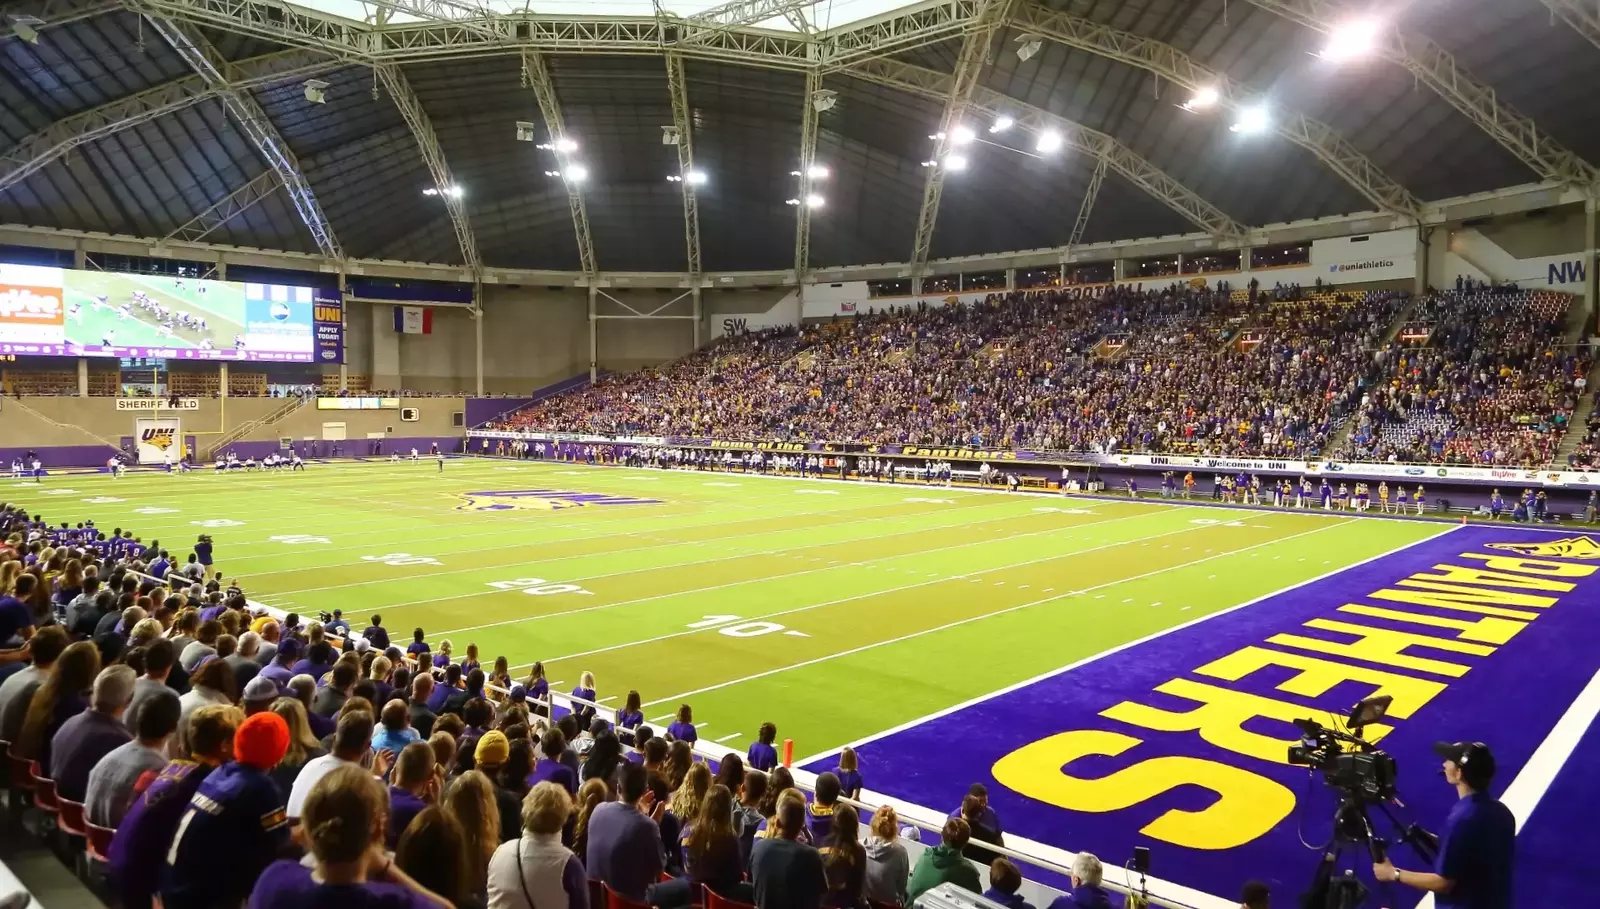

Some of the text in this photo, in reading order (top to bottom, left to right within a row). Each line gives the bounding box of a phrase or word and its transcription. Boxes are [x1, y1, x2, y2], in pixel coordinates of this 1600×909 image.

[1338, 260, 1394, 272] @uniathletics
[1548, 260, 1586, 285] NW
[314, 307, 341, 321] UNI
[319, 326, 338, 334] APPLY
[723, 318, 747, 332] SW
[119, 401, 163, 409] SHERIFF
[142, 428, 176, 441] UNI
[711, 440, 804, 451] Home of the
[903, 446, 1016, 460] Panthers
[83, 532, 92, 540] 14
[484, 578, 582, 595] 20
[684, 615, 786, 637] 10
[992, 553, 1600, 849] PANTHERS
[167, 808, 197, 866] 1
